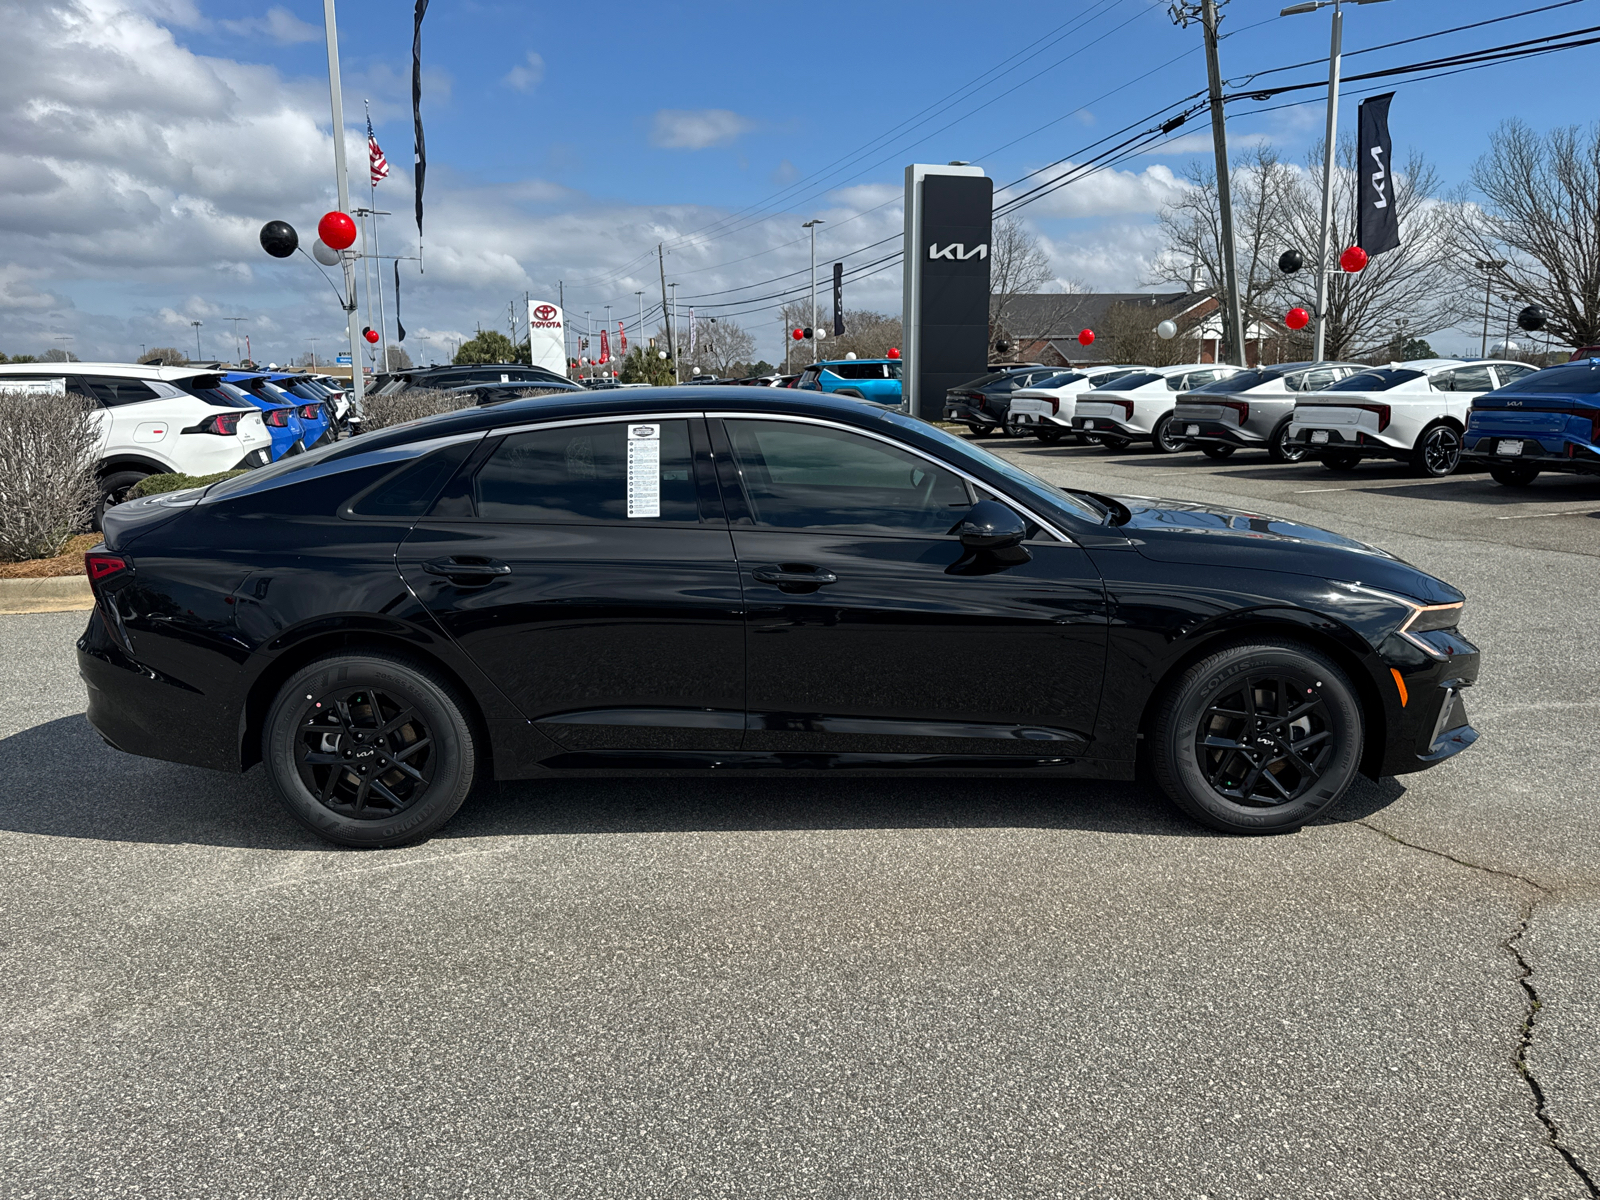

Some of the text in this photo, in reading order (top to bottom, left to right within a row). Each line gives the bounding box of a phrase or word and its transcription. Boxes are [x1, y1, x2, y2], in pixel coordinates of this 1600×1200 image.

[1370, 146, 1387, 209] KIA
[929, 243, 988, 260] KIA
[530, 321, 562, 329] TOYOTA
[1200, 661, 1250, 698] SOLUS
[356, 750, 374, 758] KIA
[382, 802, 436, 837] KUMHO
